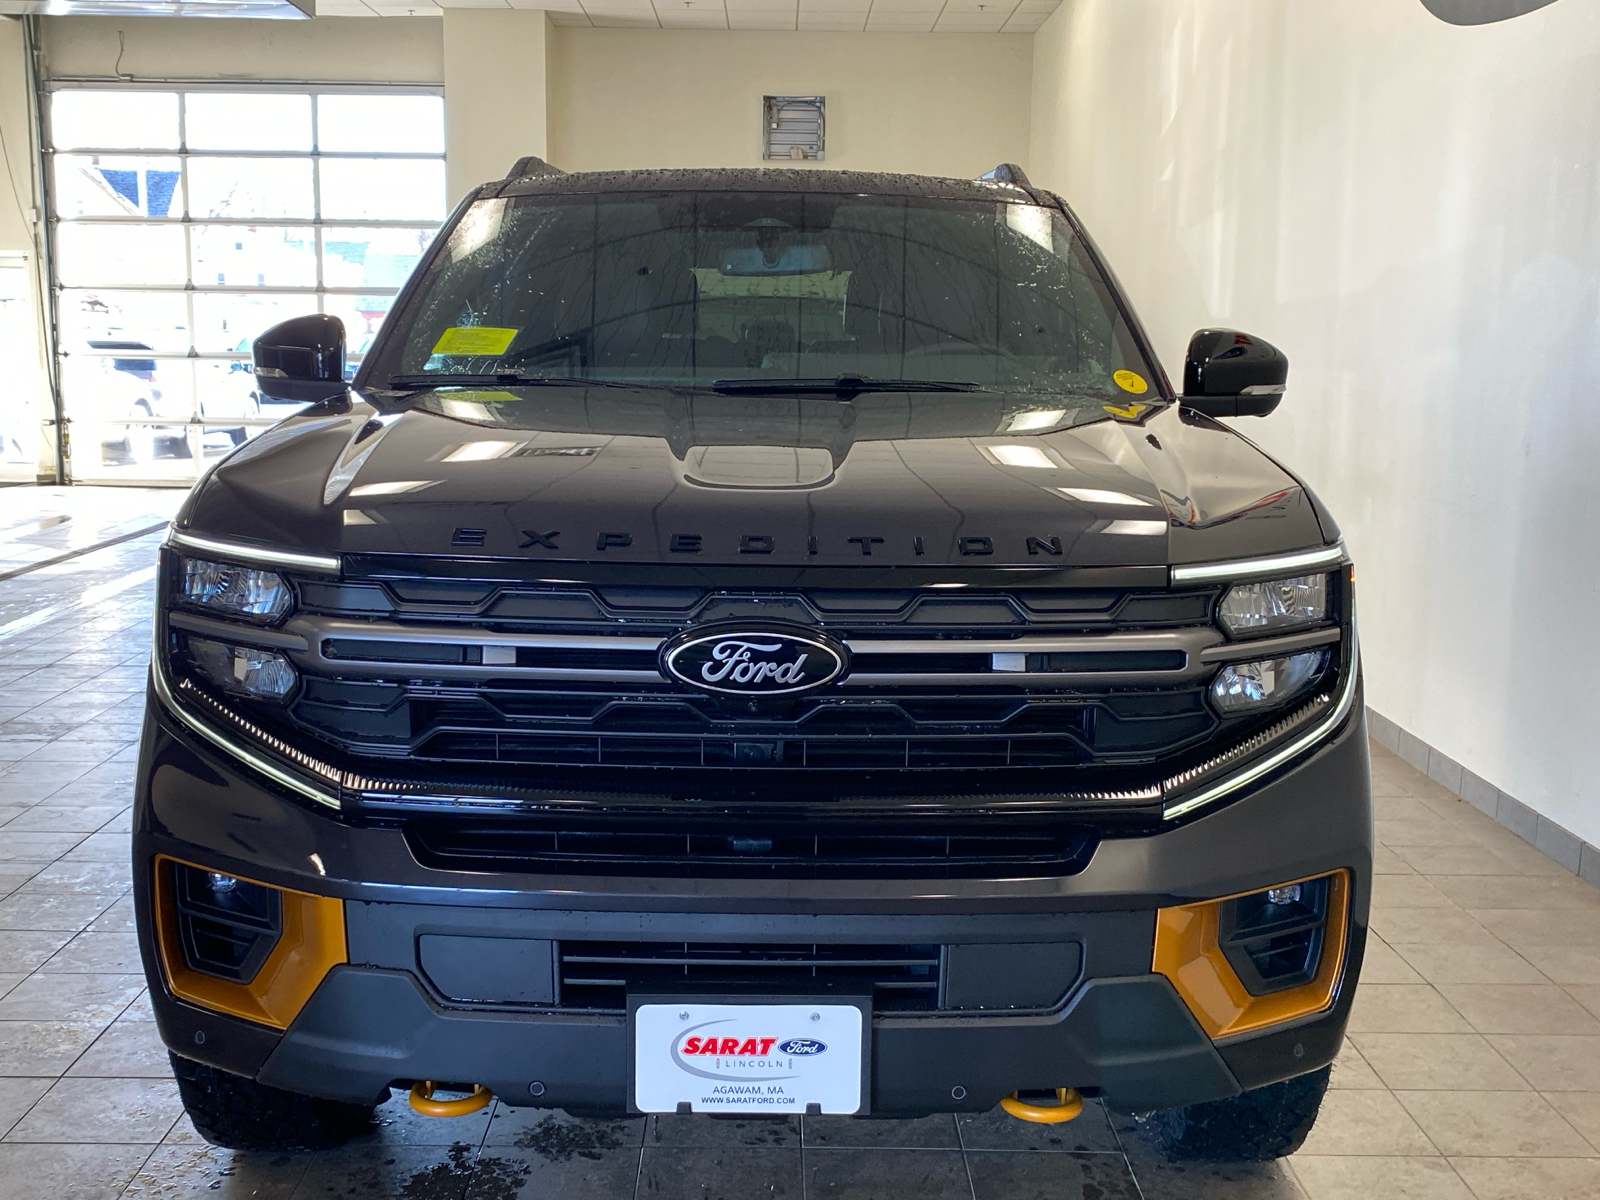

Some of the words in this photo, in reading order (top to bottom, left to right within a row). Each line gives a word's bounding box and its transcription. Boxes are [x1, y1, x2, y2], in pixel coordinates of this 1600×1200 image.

[451, 526, 1063, 556] EXPEDITION
[701, 640, 808, 684] Ford
[681, 1036, 778, 1056] SARAT
[725, 1060, 783, 1068] LINCOLN
[712, 1086, 764, 1096] AGAWAM,
[767, 1086, 785, 1095] MA
[701, 1096, 796, 1105] WWW.SARATFORD.COM
